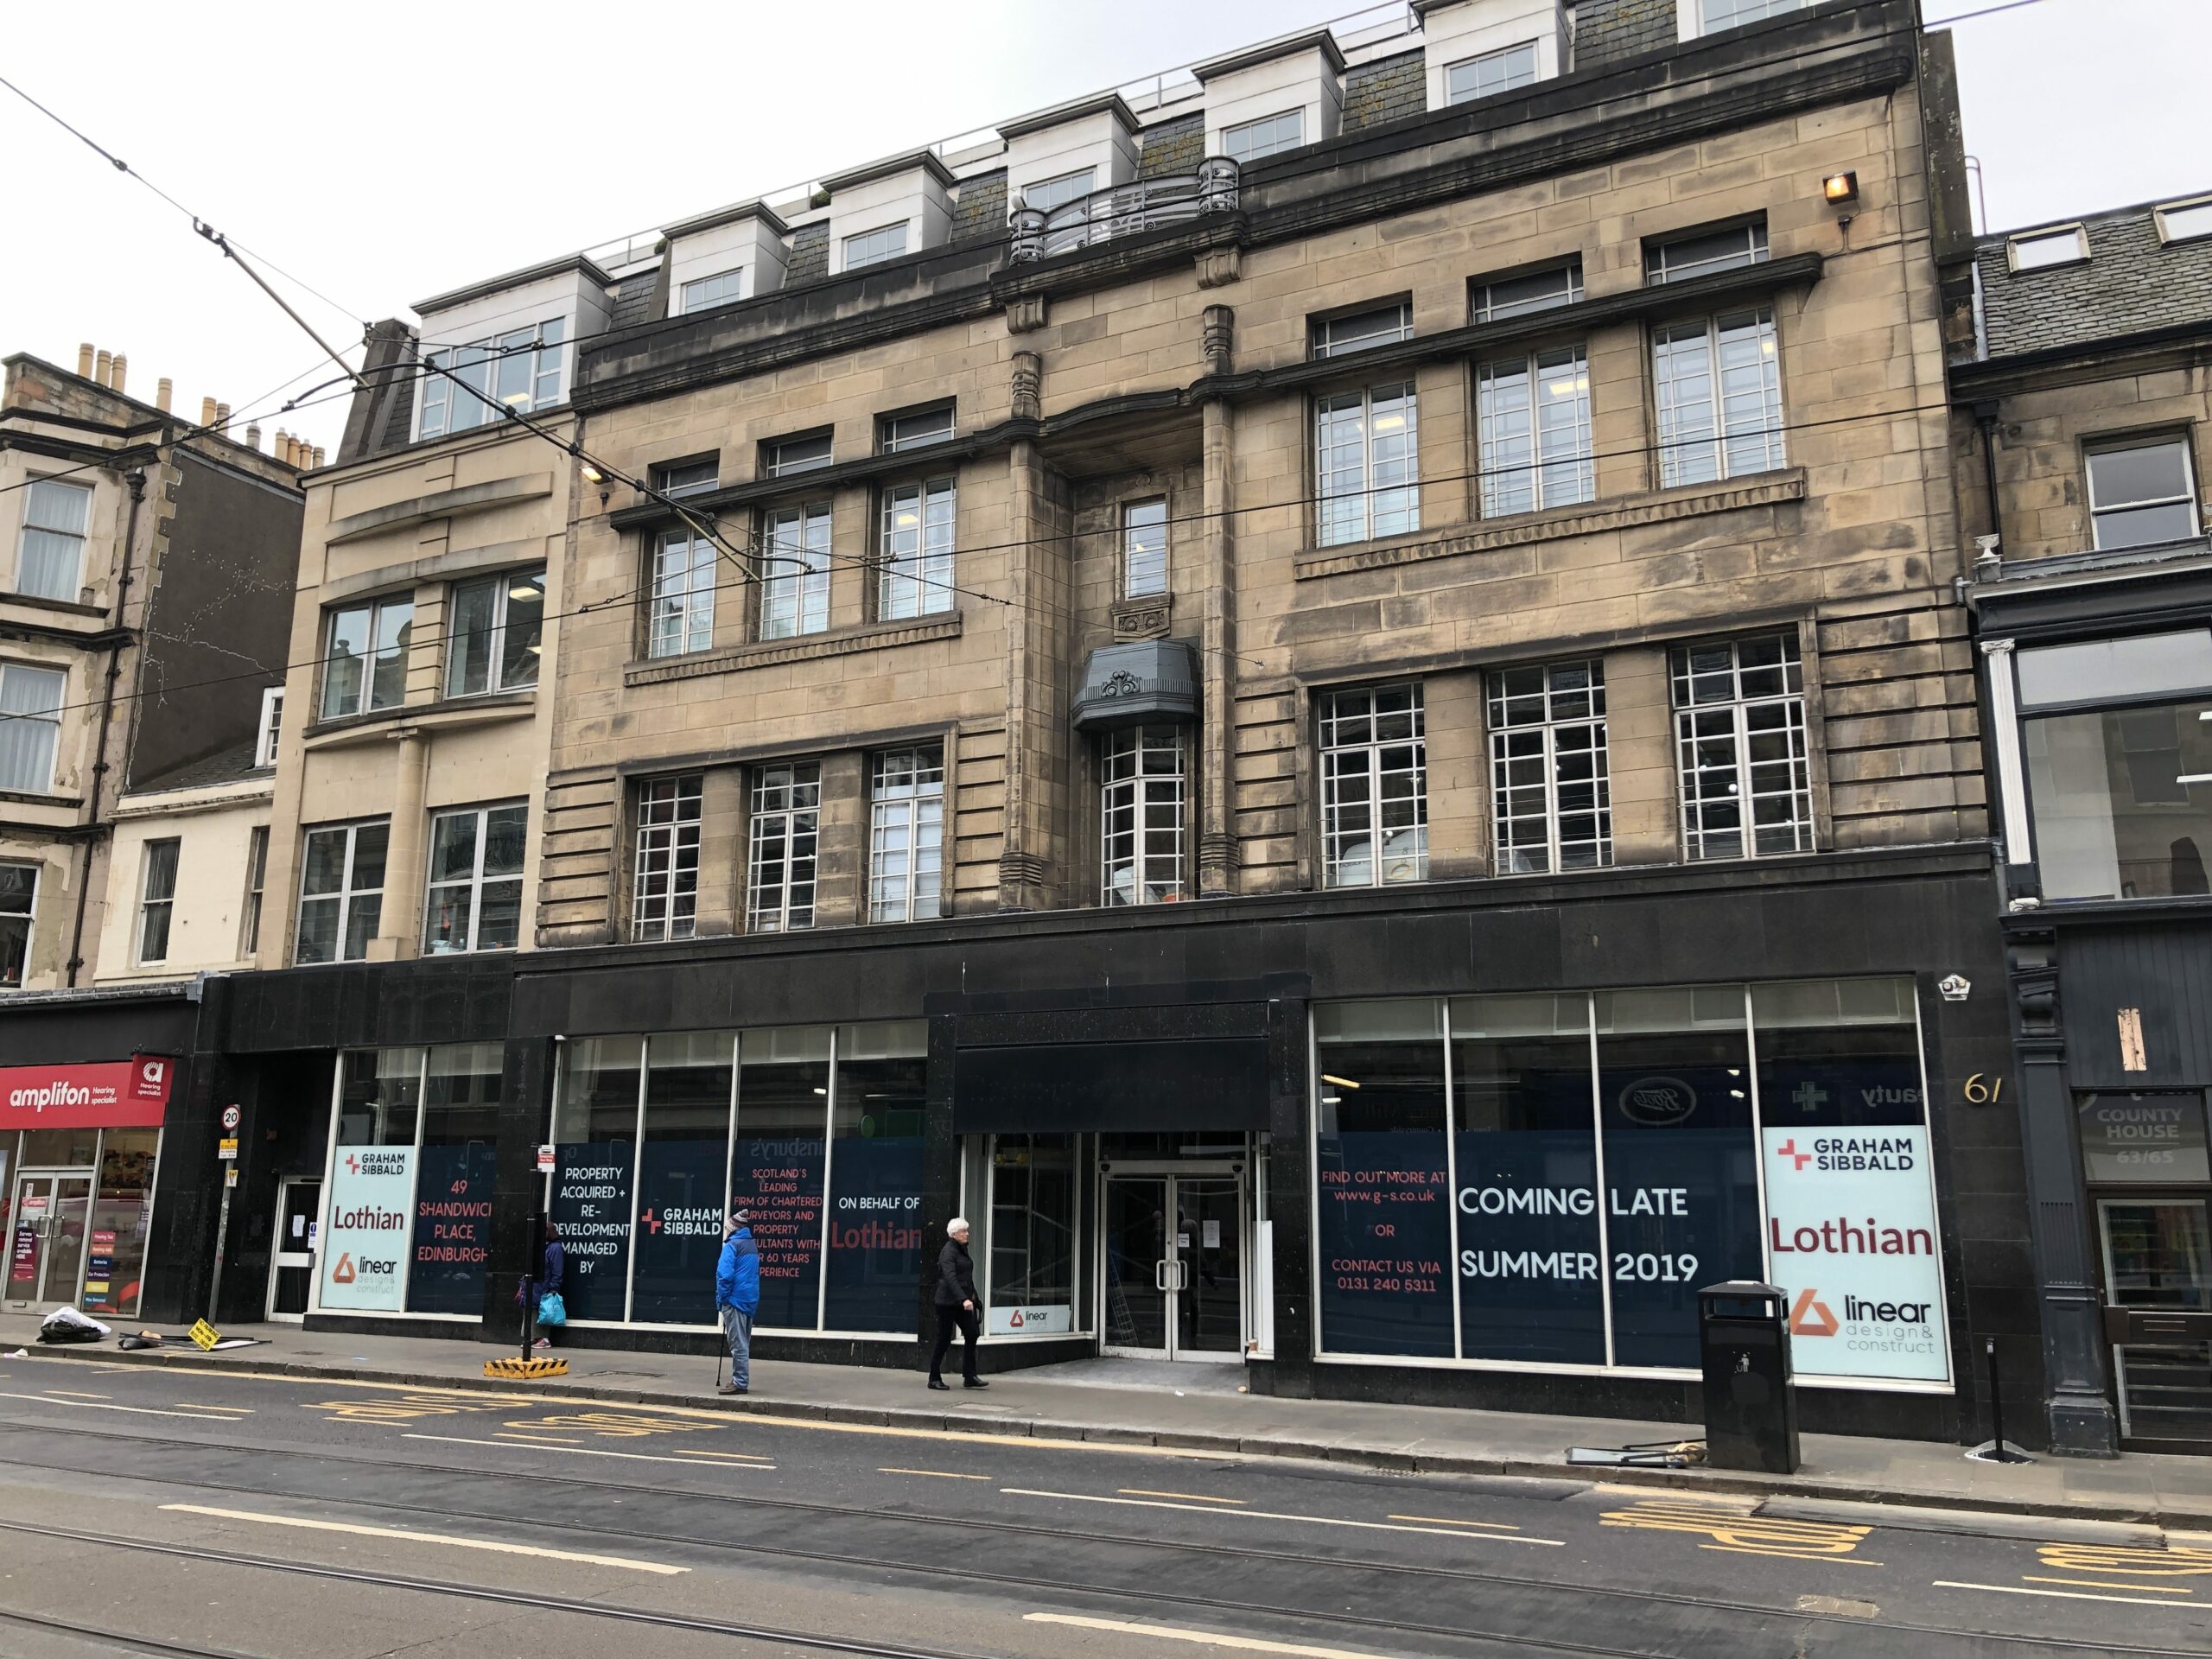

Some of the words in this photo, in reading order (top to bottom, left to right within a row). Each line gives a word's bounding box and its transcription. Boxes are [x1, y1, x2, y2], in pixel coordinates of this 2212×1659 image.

[92, 1086, 116, 1095] Hearing
[140, 1082, 161, 1090] Hearing
[1964, 1072, 2002, 1103] 61
[10, 1081, 90, 1112] amplifon
[91, 1096, 117, 1105] specialist
[225, 1112, 238, 1122] 20
[2097, 1108, 2183, 1122] COUNTY
[2106, 1124, 2180, 1139] HOUSE
[1814, 1138, 1914, 1154] GRAHAM
[362, 1154, 405, 1164] GRAHAM
[1817, 1155, 1915, 1171] SIBBALD
[2117, 1150, 2175, 1165] 63/65
[361, 1165, 404, 1175] SIBBALD
[565, 1167, 624, 1180] PROPERTY
[752, 1168, 807, 1179] SCOTLAND'S
[1322, 1171, 1350, 1182] FIND
[1355, 1172, 1382, 1183] OUT
[1386, 1172, 1425, 1183] MORE
[1430, 1172, 1446, 1183] AT
[450, 1179, 467, 1194] 49
[560, 1186, 616, 1198] ACQUIRED
[760, 1182, 798, 1192] LEADING
[734, 1197, 754, 1206] FIRM
[757, 1197, 770, 1206] OF
[771, 1196, 823, 1206] CHARTERED
[838, 1197, 857, 1209] ON
[860, 1197, 901, 1209] BEHALF
[904, 1197, 920, 1209] OF
[1458, 1187, 1595, 1215] COMING
[1611, 1188, 1689, 1216] LATE
[334, 1205, 404, 1230] Lothian
[581, 1205, 601, 1217] RE-
[664, 1208, 722, 1222] GRAHAM
[747, 1211, 791, 1220] URVEYORS
[795, 1211, 815, 1220] AND
[434, 1224, 476, 1243] PLACE,
[663, 1222, 721, 1236] SIBBALD
[753, 1224, 799, 1235] PROPERTY
[831, 1220, 922, 1249] Lothian
[1375, 1224, 1395, 1236] OR
[1770, 1217, 1934, 1255] Lothian
[562, 1242, 618, 1255] MANAGED
[756, 1238, 793, 1249] ULTANTS
[796, 1239, 821, 1249] WITH
[359, 1255, 397, 1274] linear
[766, 1253, 779, 1262] 60
[781, 1253, 810, 1263] YEARS
[580, 1261, 594, 1274] BY
[760, 1267, 800, 1277] PERIENCE
[1332, 1259, 1392, 1273] CONTACT
[1396, 1261, 1414, 1274] US
[1418, 1261, 1442, 1274] VIA
[1460, 1249, 1599, 1281] SUMMER
[1614, 1253, 1700, 1282] 2019
[356, 1285, 395, 1294] construct
[1338, 1277, 1370, 1289] 0131
[1373, 1278, 1400, 1291] 240
[1404, 1279, 1436, 1293] 5311
[1025, 1310, 1048, 1321] linear
[1845, 1294, 1932, 1324] linear
[1847, 1339, 1936, 1354] construct
